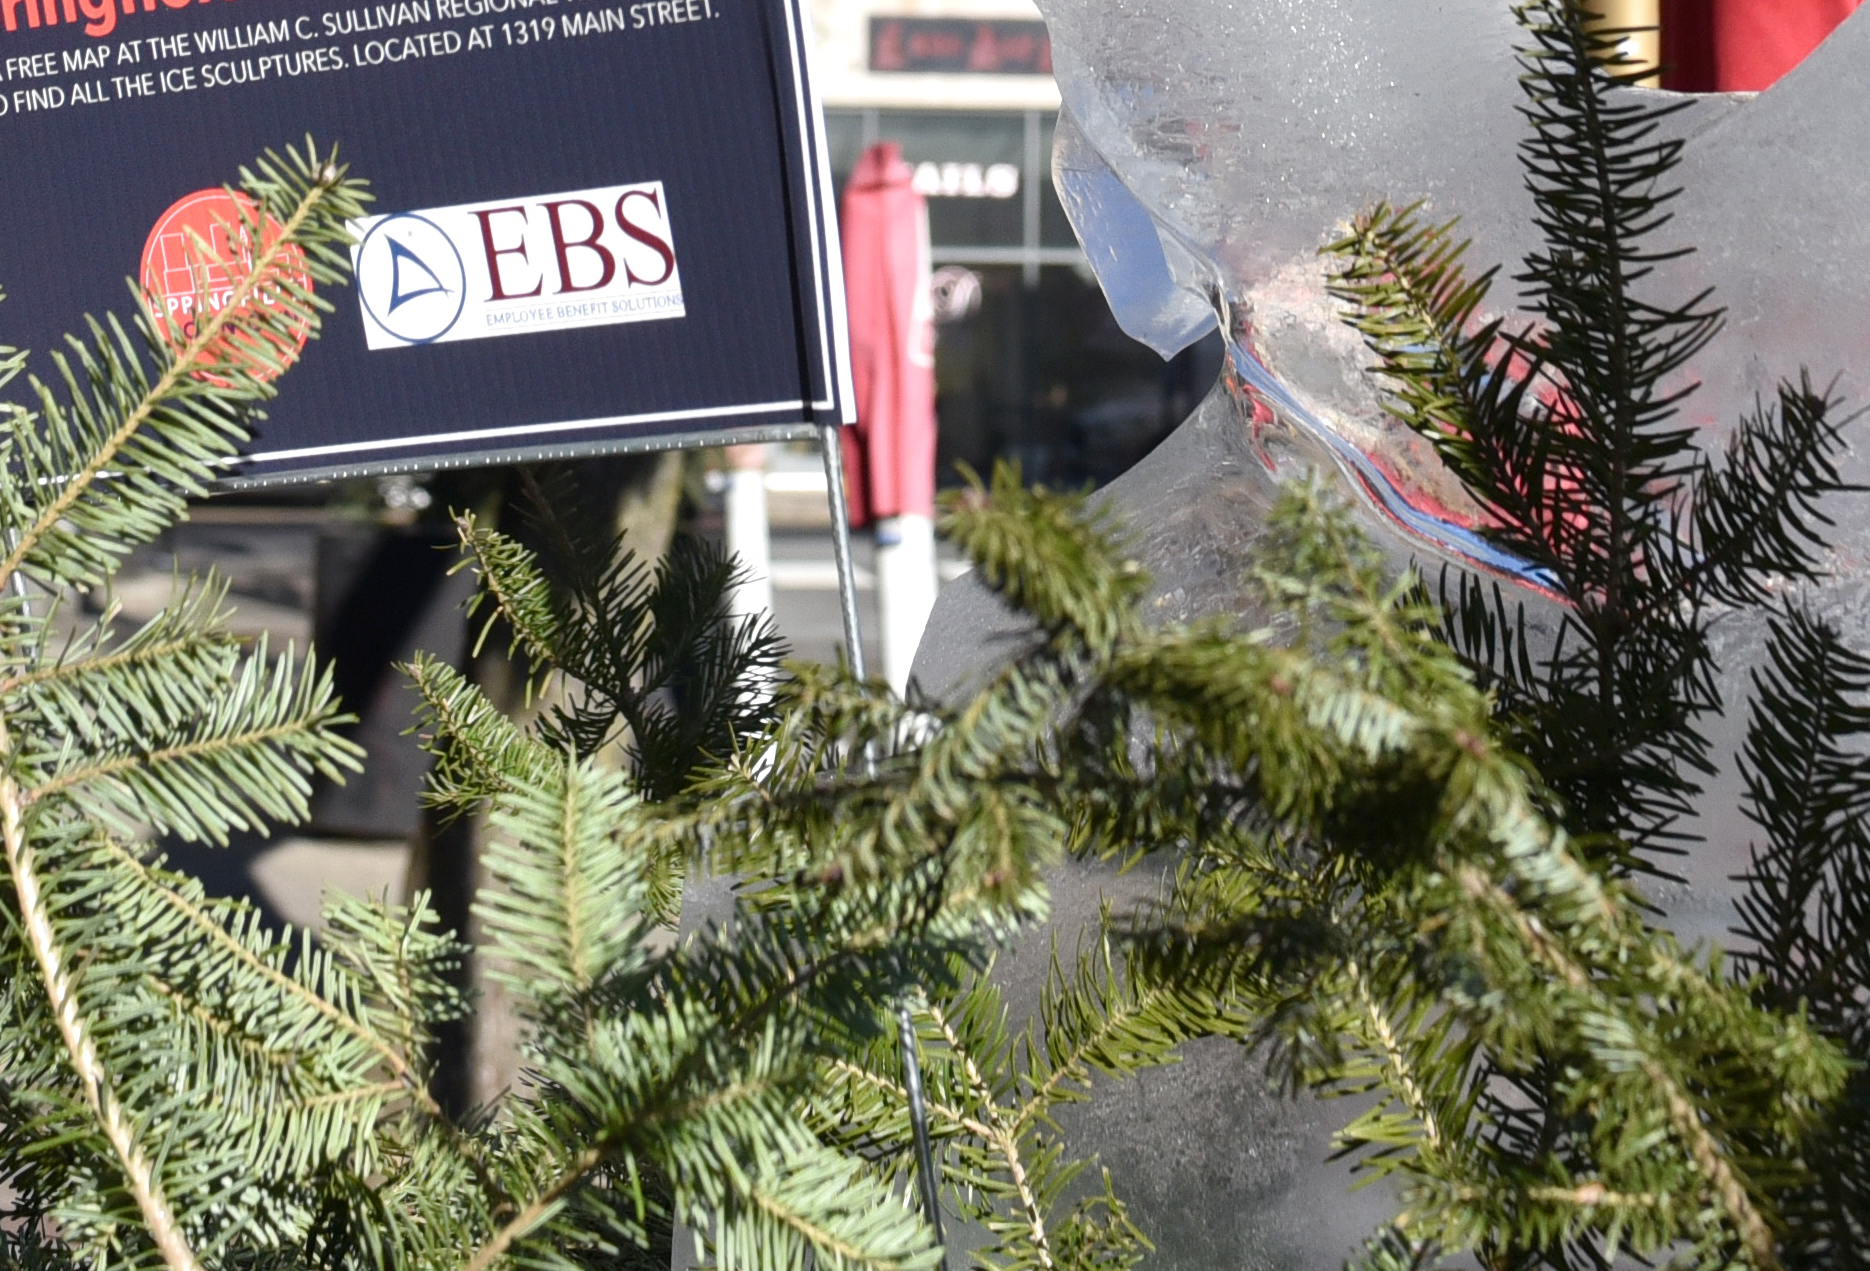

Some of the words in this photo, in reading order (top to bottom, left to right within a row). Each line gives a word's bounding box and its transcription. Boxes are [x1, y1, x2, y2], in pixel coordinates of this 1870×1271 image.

[4, 51, 59, 81] FREE
[61, 44, 111, 73] MAP
[116, 38, 142, 66] AT
[144, 32, 192, 60] THE
[192, 17, 290, 54] WILLIAM
[293, 15, 319, 40] C.
[12, 85, 65, 113] FIND
[69, 79, 111, 106] ALL
[109, 71, 156, 99] THE
[158, 65, 198, 93] ICE
[200, 45, 349, 88] SCULPTURES.
[352, 29, 462, 67] LOCATED
[467, 23, 494, 51] AT
[500, 15, 556, 46] 1319
[560, 6, 625, 38] MAIN
[467, 186, 675, 303] EBS
[485, 307, 553, 327] EMPLOYEE
[556, 300, 608, 319] BENEFIT
[611, 293, 686, 314] SOLUTIONS
